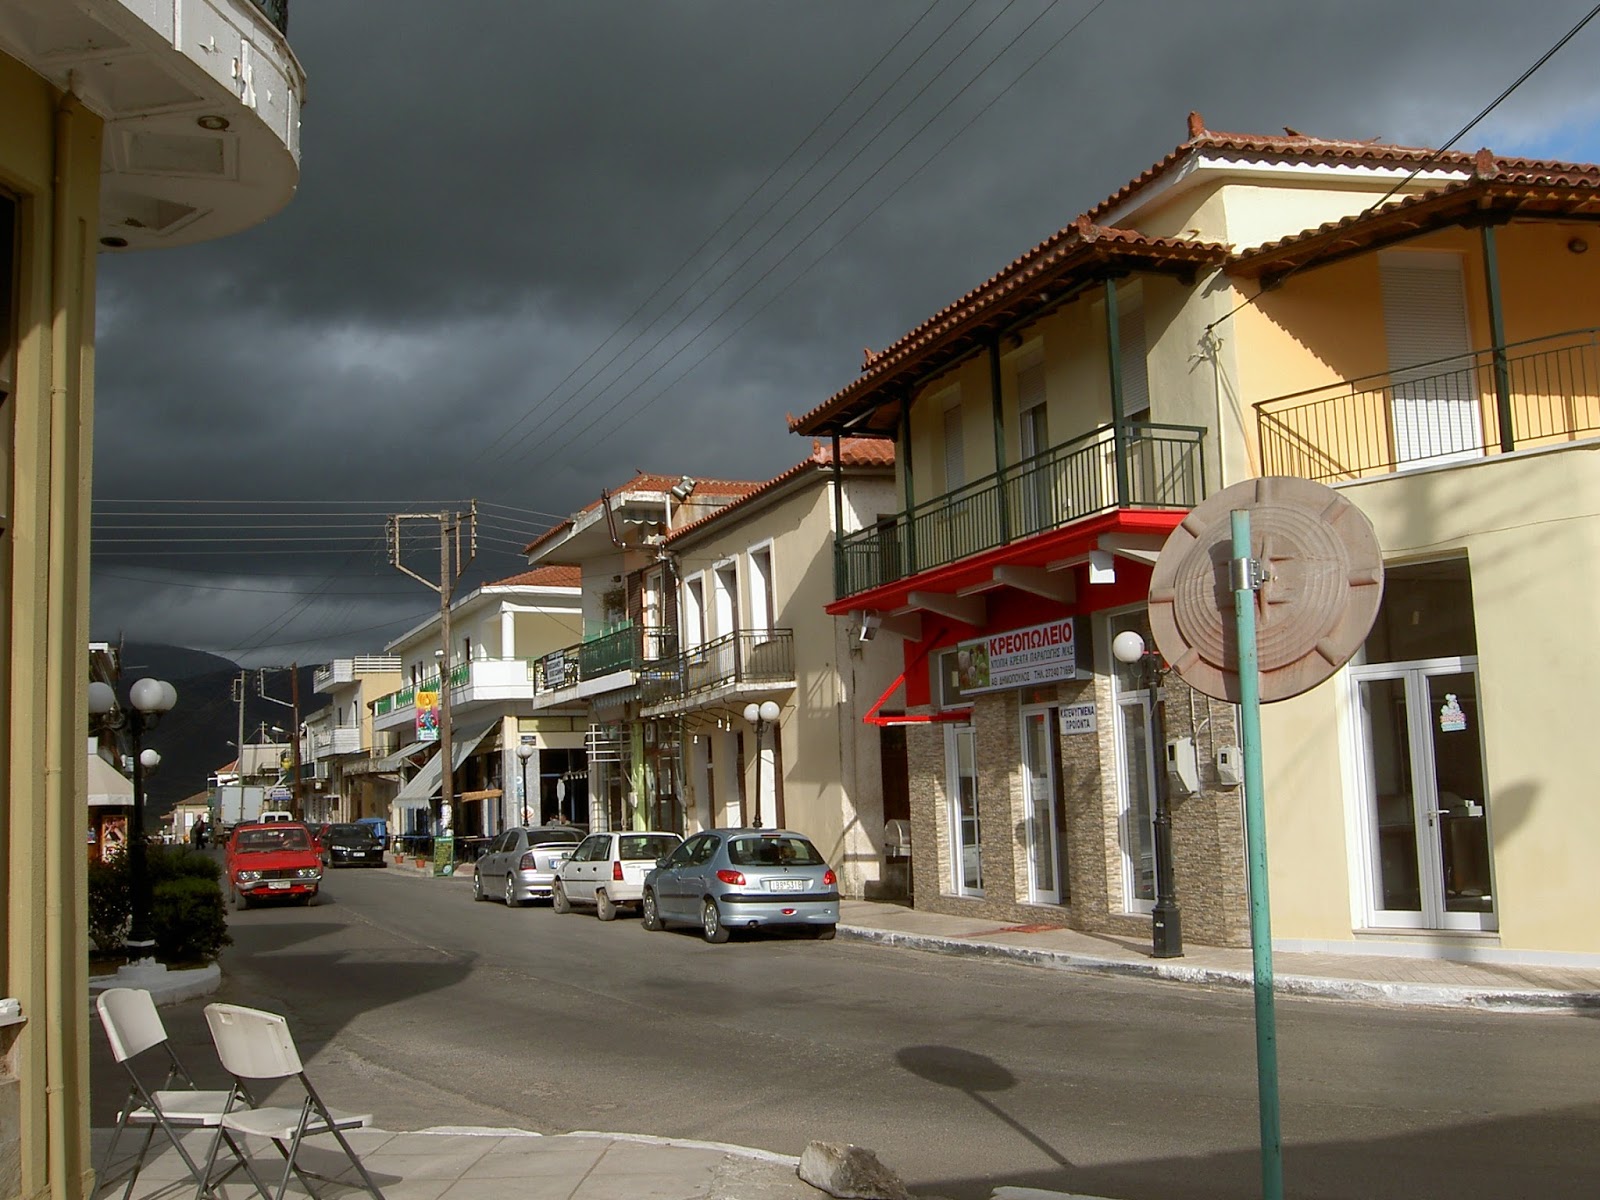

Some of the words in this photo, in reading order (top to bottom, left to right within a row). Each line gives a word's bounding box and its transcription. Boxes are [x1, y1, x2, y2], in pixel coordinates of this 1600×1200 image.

[989, 622, 1072, 656] ΚΡΕΟΠΩΛΕΙΟ
[1010, 653, 1028, 665] ΚΡΕΑΤΑ
[1030, 647, 1060, 662] ΠΑΡΑΓΩΓΗΣ
[1062, 645, 1073, 656] ΜΑΣ
